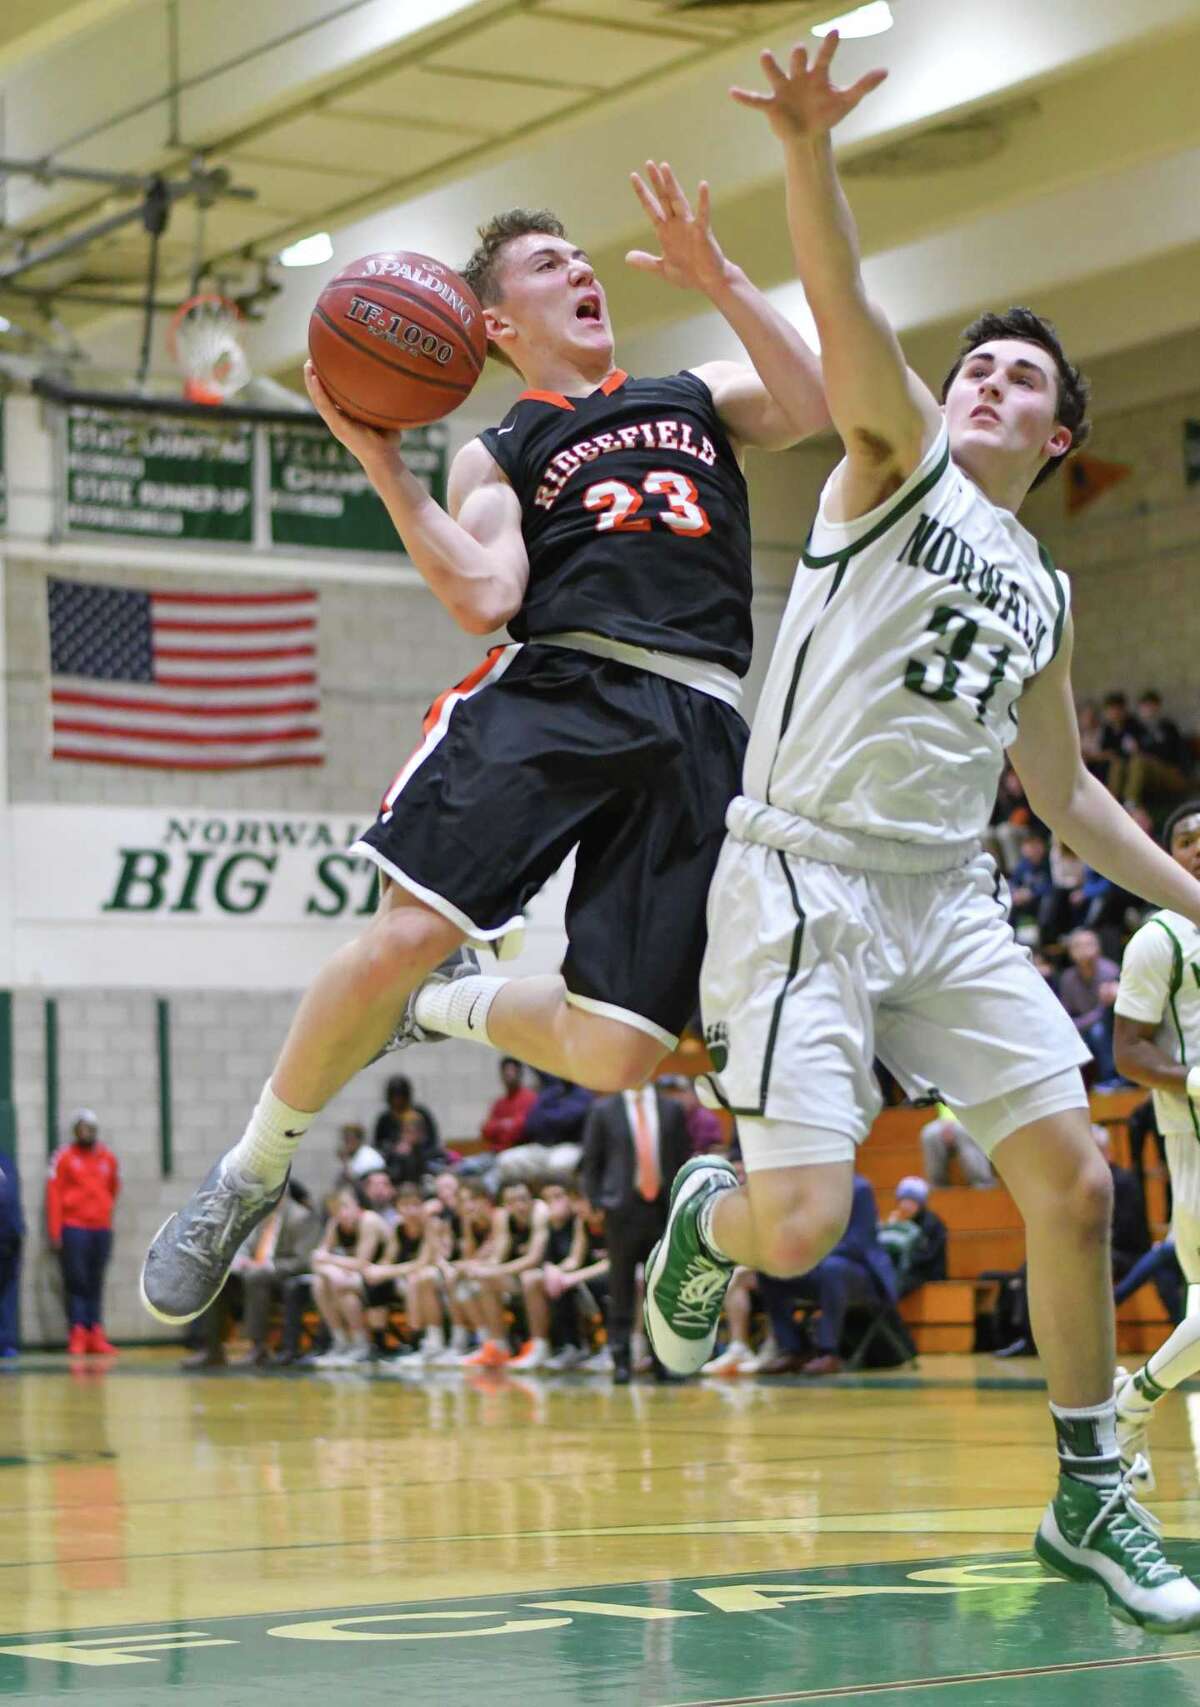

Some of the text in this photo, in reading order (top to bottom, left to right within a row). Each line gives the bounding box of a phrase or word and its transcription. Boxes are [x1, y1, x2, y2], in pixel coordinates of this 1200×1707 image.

[362, 259, 475, 329] SPALDING
[347, 297, 454, 364] TF-1000
[533, 420, 718, 511] RIDGEFIELD
[582, 469, 712, 538] 23
[100, 847, 278, 915] BIG
